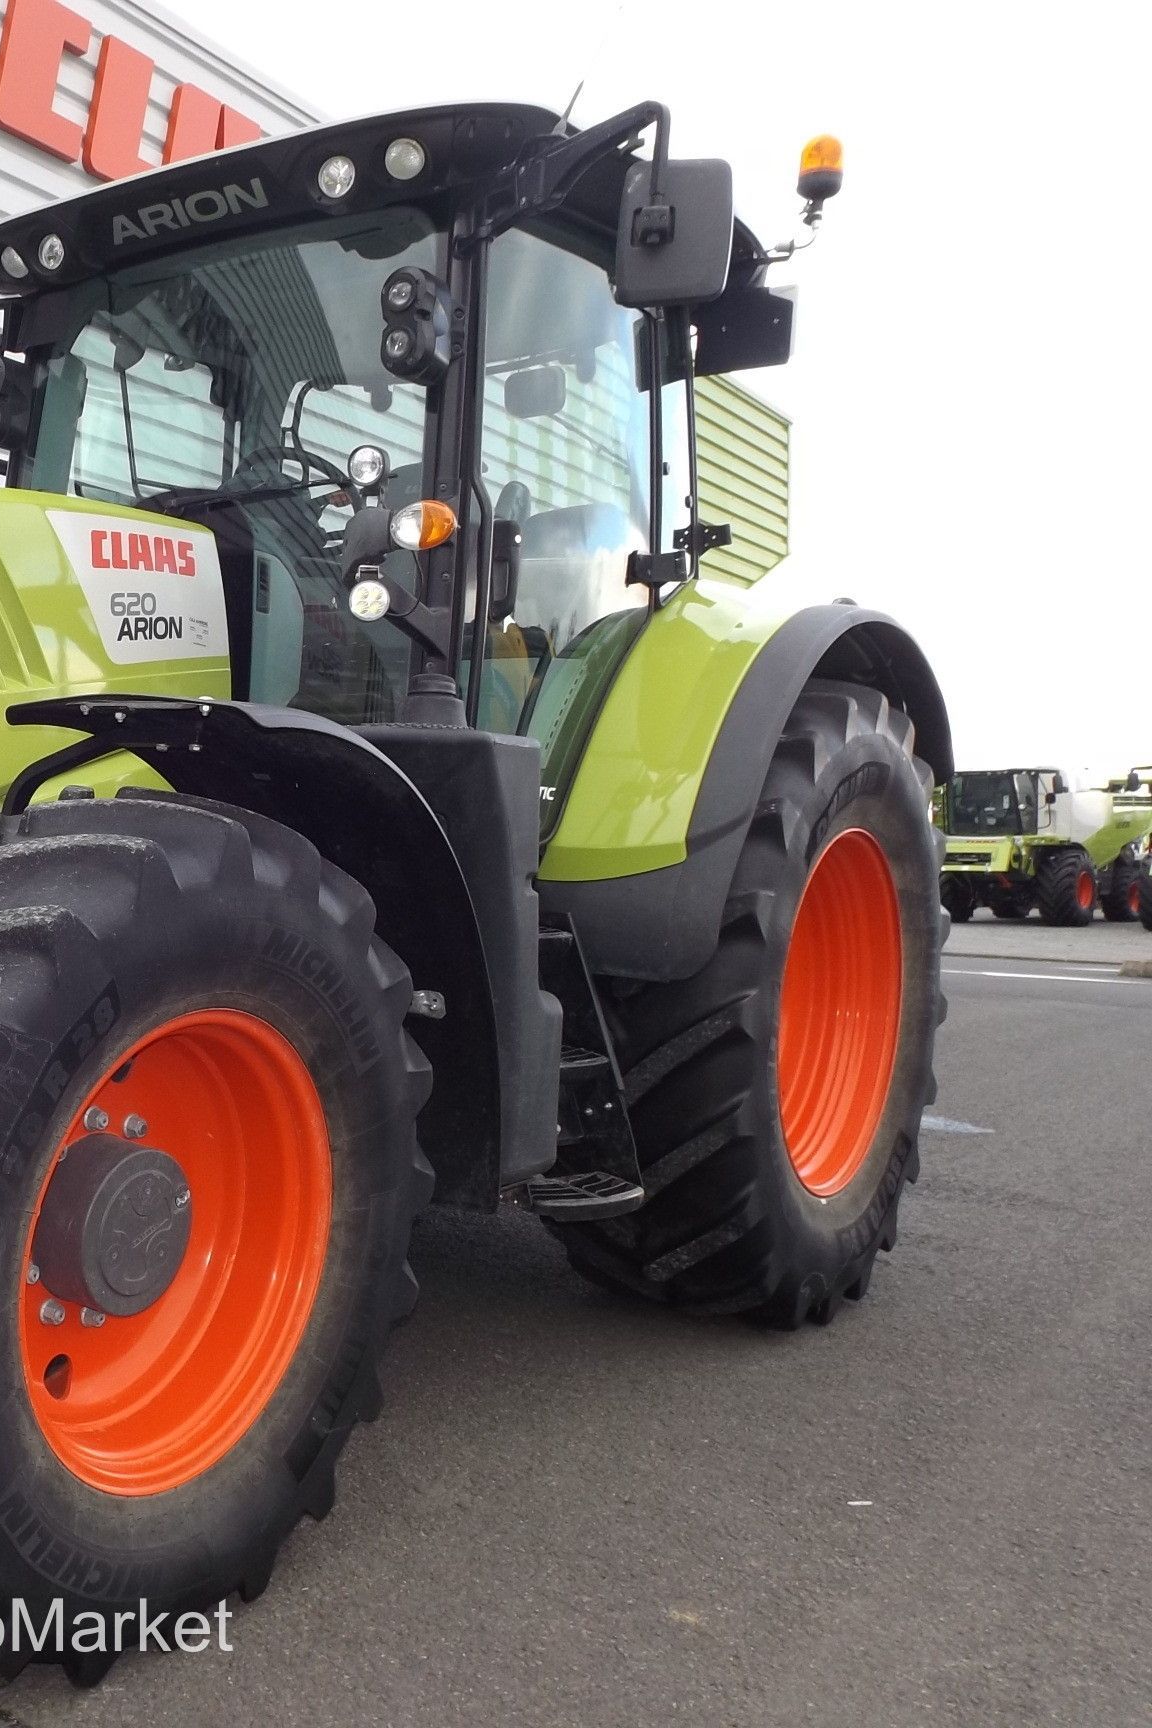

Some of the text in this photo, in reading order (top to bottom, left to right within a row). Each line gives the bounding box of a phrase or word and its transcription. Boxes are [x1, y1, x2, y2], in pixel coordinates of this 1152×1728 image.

[111, 177, 270, 246] ARION
[91, 529, 196, 577] CLAAS
[110, 592, 157, 617] 620
[116, 616, 183, 642] ARION
